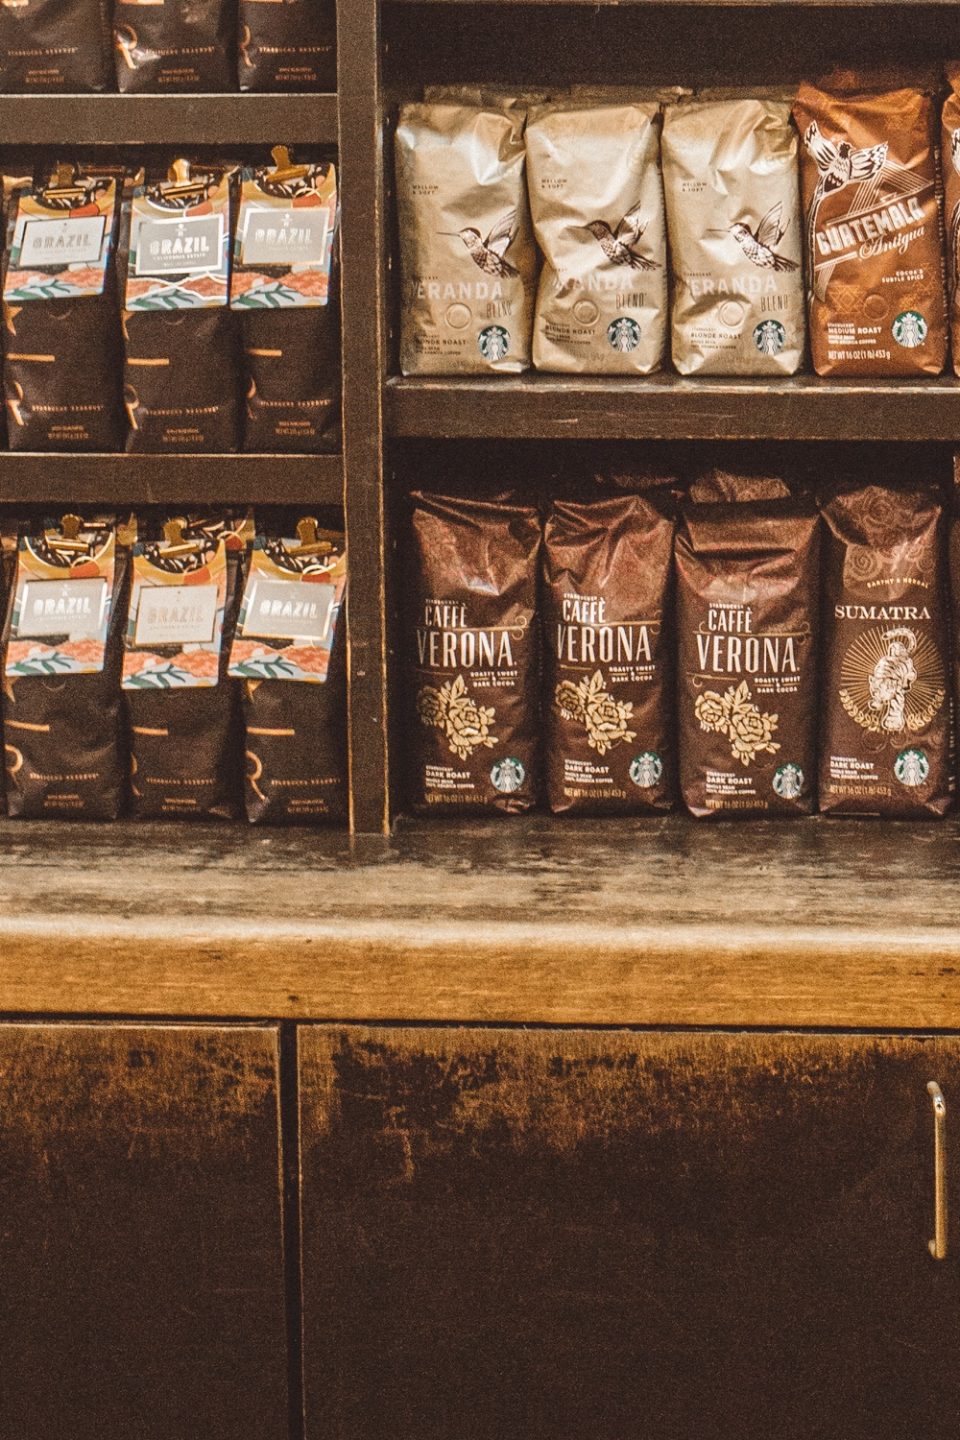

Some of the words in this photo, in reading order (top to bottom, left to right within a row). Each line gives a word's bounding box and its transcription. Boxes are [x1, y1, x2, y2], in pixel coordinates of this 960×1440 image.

[815, 196, 926, 256] GUATEMALA
[858, 226, 925, 259] Antigua
[562, 598, 607, 624] CAFFÈ
[708, 606, 752, 633] CAFFÈ
[834, 605, 931, 620] SUMATRA
[416, 629, 513, 668] VERONA
[556, 624, 652, 663] VERONA
[696, 633, 797, 674] VERONA
[426, 771, 444, 779] DARK
[446, 771, 470, 779] ROAST
[830, 761, 849, 769] DARK
[851, 762, 874, 770] ROAST
